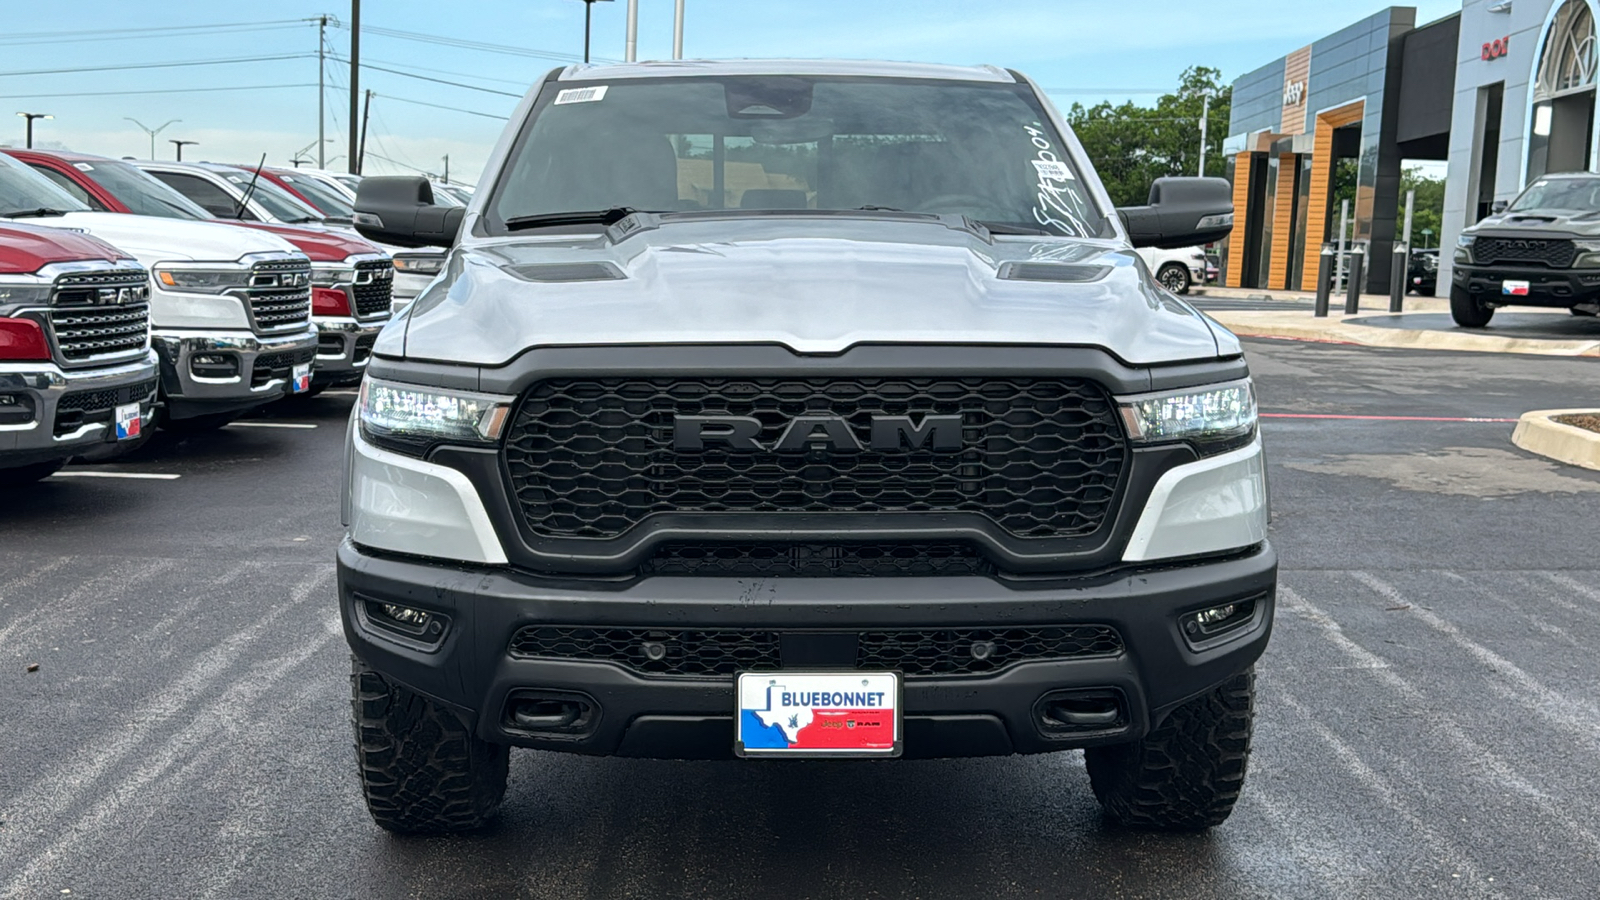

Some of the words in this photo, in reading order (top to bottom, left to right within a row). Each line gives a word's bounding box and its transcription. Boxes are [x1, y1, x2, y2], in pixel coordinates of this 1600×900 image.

[1495, 239, 1548, 249] RAM
[98, 287, 144, 306] RAM
[673, 414, 963, 452] RAM
[781, 691, 885, 707] BLUEBONNET
